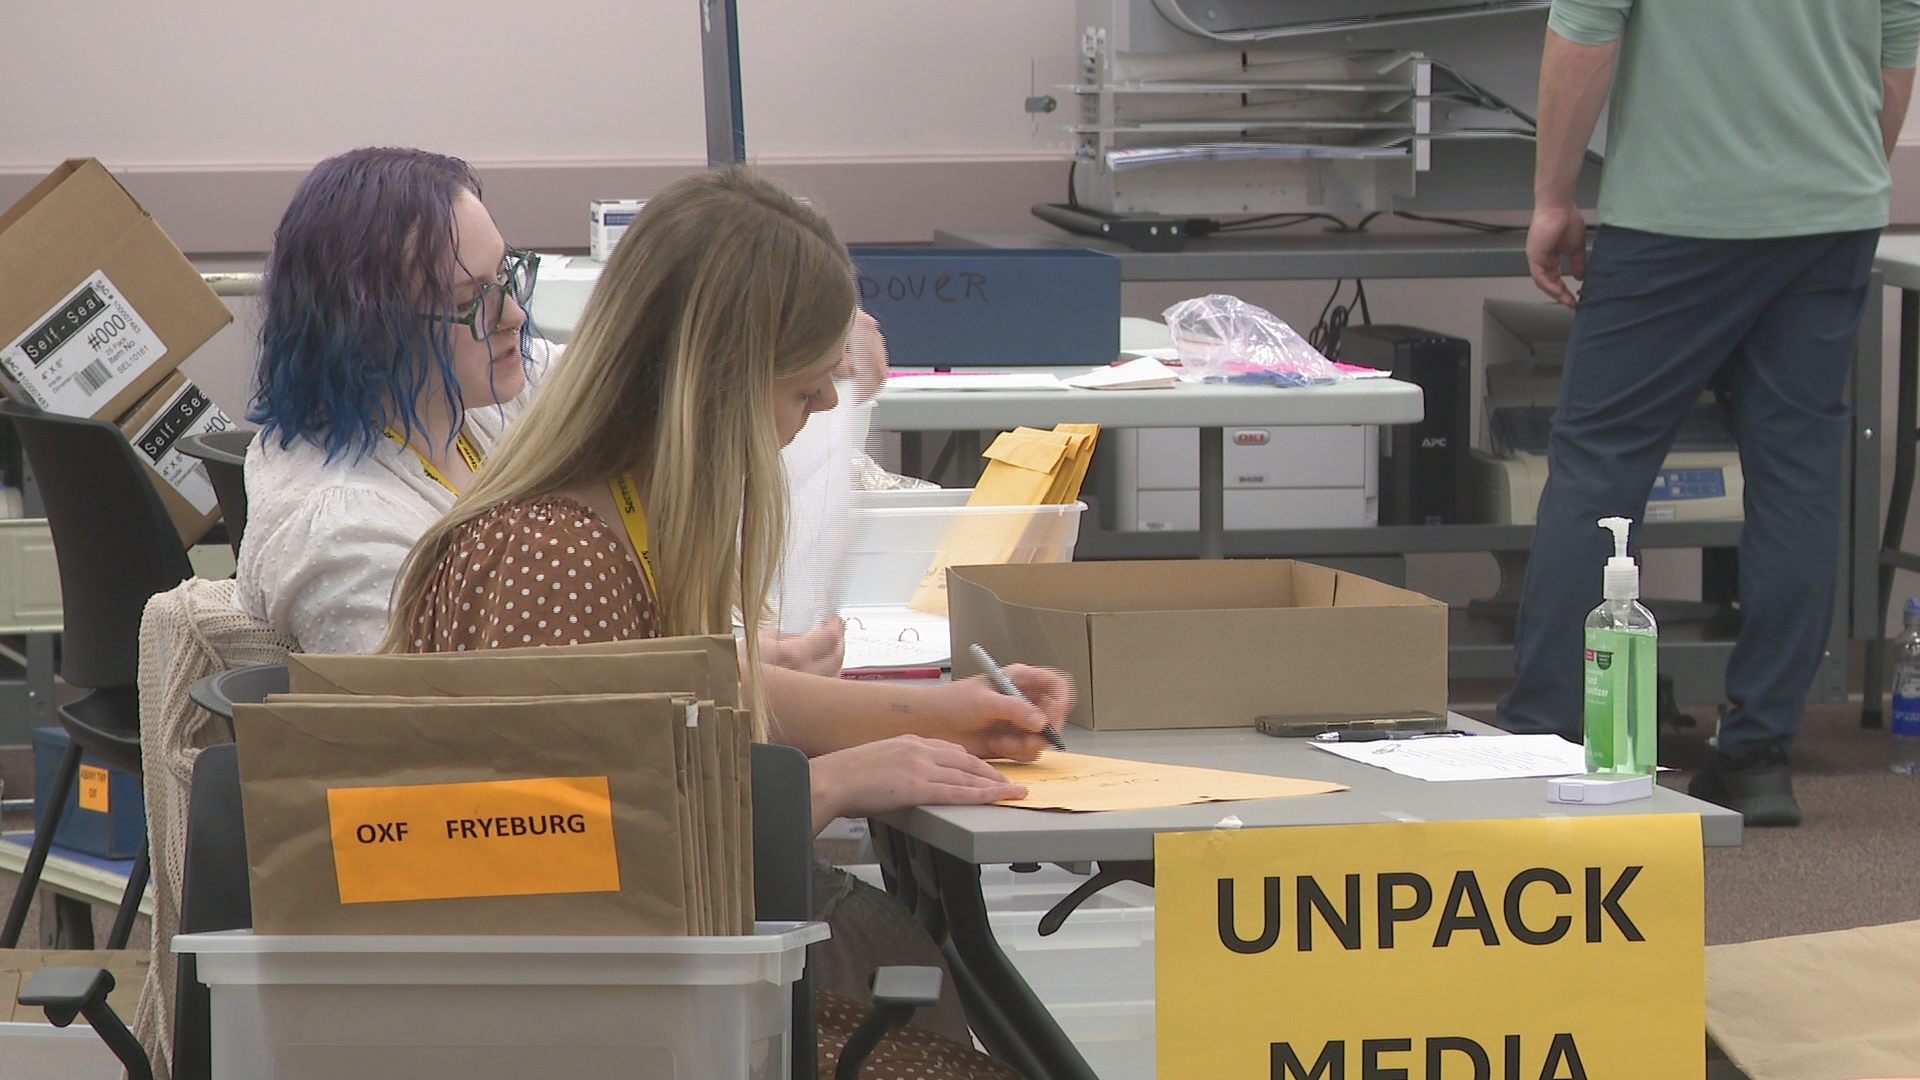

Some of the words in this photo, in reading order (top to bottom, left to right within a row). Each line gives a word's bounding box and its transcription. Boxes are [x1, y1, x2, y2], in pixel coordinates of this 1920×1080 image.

[87, 314, 126, 352] #000
[107, 350, 125, 364] Item
[123, 340, 136, 351] No
[1421, 438, 1447, 448] APC
[356, 822, 409, 844] OXF
[446, 814, 586, 840] FRYEBURG
[1216, 865, 1647, 955] UNPACK
[1270, 1033, 1590, 1080] MEDIA
